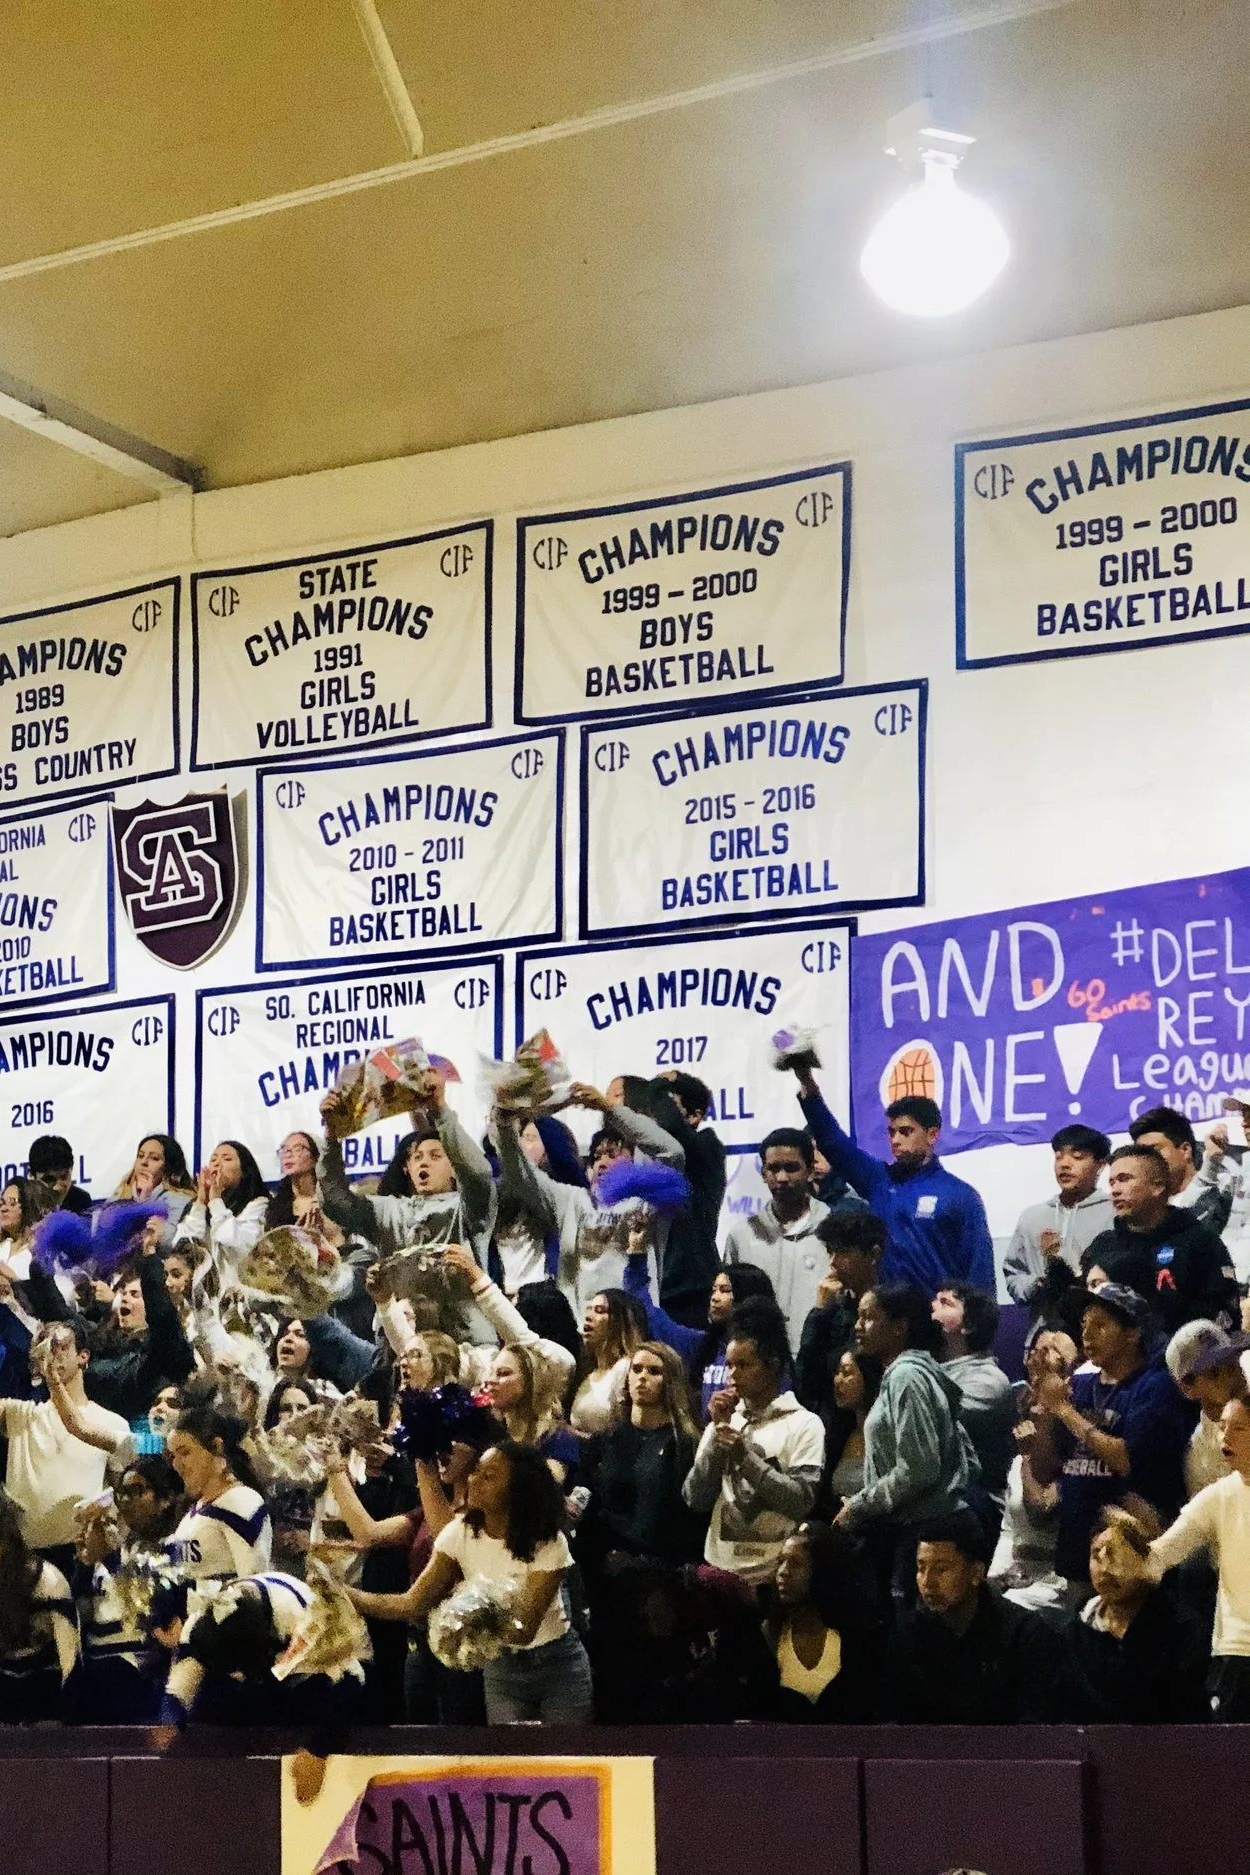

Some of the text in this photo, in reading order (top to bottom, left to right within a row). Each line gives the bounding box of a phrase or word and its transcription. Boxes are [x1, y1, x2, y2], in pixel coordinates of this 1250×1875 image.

[974, 464, 1014, 500] CIF
[796, 492, 833, 527] CIF
[1056, 516, 1123, 549] 1999
[1161, 497, 1237, 533] 2000
[440, 544, 473, 577] CIF
[533, 537, 568, 570] CIF
[577, 513, 785, 585] CHAMPIONS
[1100, 543, 1192, 587] GIRLS
[300, 559, 377, 599] STATE
[602, 584, 659, 614] 1999
[693, 568, 757, 601] 2000
[132, 600, 161, 632] CIF
[209, 586, 240, 617] CIF
[245, 596, 433, 672] CHAMPIONS
[640, 611, 713, 649] BOYS
[314, 643, 362, 672] 1991
[586, 645, 774, 697] BASKETBALL
[16, 684, 64, 714] 1989
[301, 671, 375, 709] GIRLS
[12, 716, 69, 752] BOYS
[256, 699, 419, 750] VOLLEYBALL
[875, 704, 912, 735] CIF
[35, 738, 138, 785] COUNTRY
[511, 749, 543, 779] CIF
[595, 742, 630, 772] CIF
[651, 718, 850, 788] CHAMPIONS
[276, 780, 305, 808] CIF
[685, 794, 736, 824] 2015
[763, 784, 815, 814] 2016
[68, 814, 96, 842] CIF
[318, 783, 499, 848] CHAMPIONS
[350, 844, 396, 872] 2010
[422, 837, 463, 864] 2011
[710, 823, 788, 862] GIRLS
[372, 870, 440, 906] GIRLS
[662, 860, 838, 910] BASKETBALL
[330, 902, 482, 946] BASKETBALL
[801, 941, 841, 973] CIF
[881, 921, 1065, 1029] AND
[266, 980, 425, 1020] SO. CALIFORNIA
[454, 978, 489, 1009] CIF
[530, 969, 567, 1000] CIF
[587, 968, 781, 1030] CHAMPIONS
[1067, 978, 1106, 1008] 60
[132, 1017, 163, 1046] CIF
[208, 1006, 240, 1036] CIF
[297, 1015, 394, 1048] REGIONAL
[1157, 987, 1250, 1050] REY
[656, 1036, 707, 1065] 2017
[1112, 1051, 1250, 1092] Leagu
[12, 1100, 53, 1127] 2016
